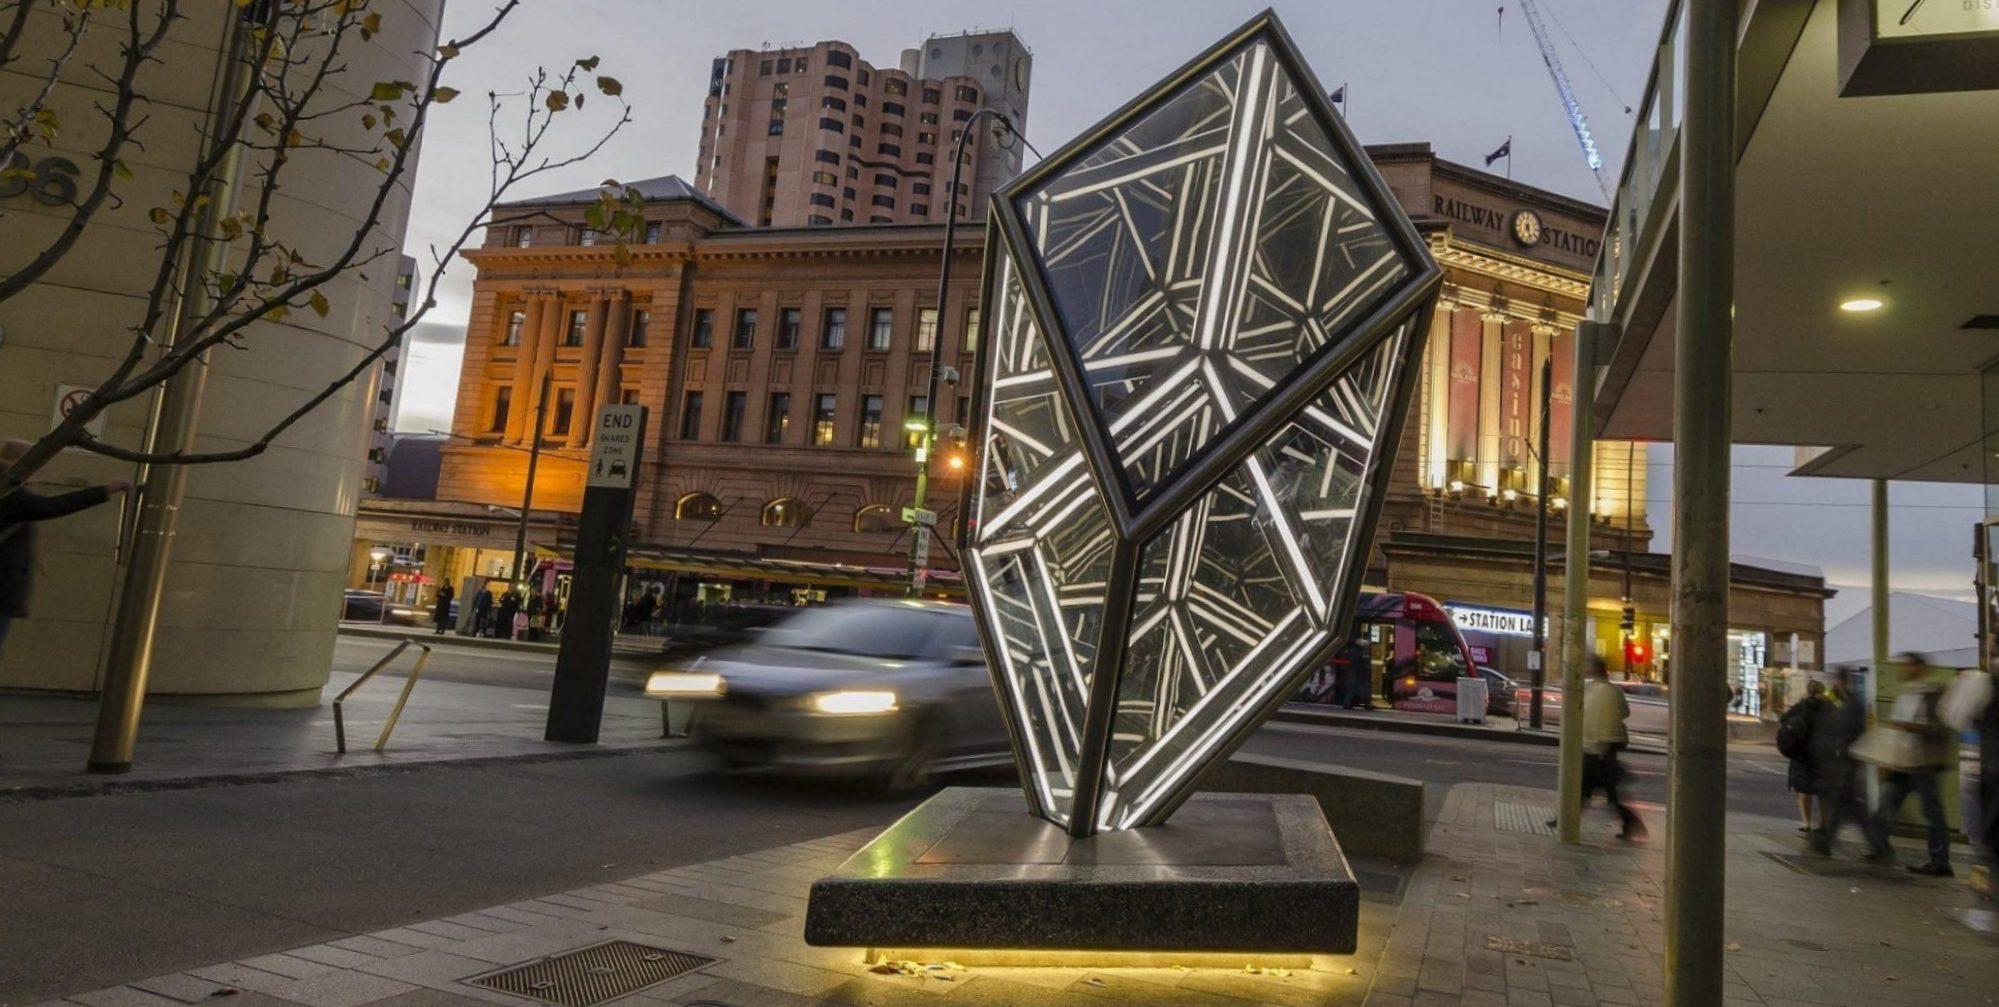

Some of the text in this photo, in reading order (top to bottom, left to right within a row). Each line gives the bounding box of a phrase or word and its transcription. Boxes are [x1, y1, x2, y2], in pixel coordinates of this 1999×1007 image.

[1963, 0, 1999, 11] DIS
[1434, 195, 1601, 257] RAILWAY STATIO
[603, 414, 632, 428] END
[600, 433, 630, 443] SHARED
[603, 446, 624, 455] ZONE
[452, 522, 490, 536] STATION
[1469, 612, 1546, 635] STATION LAE
